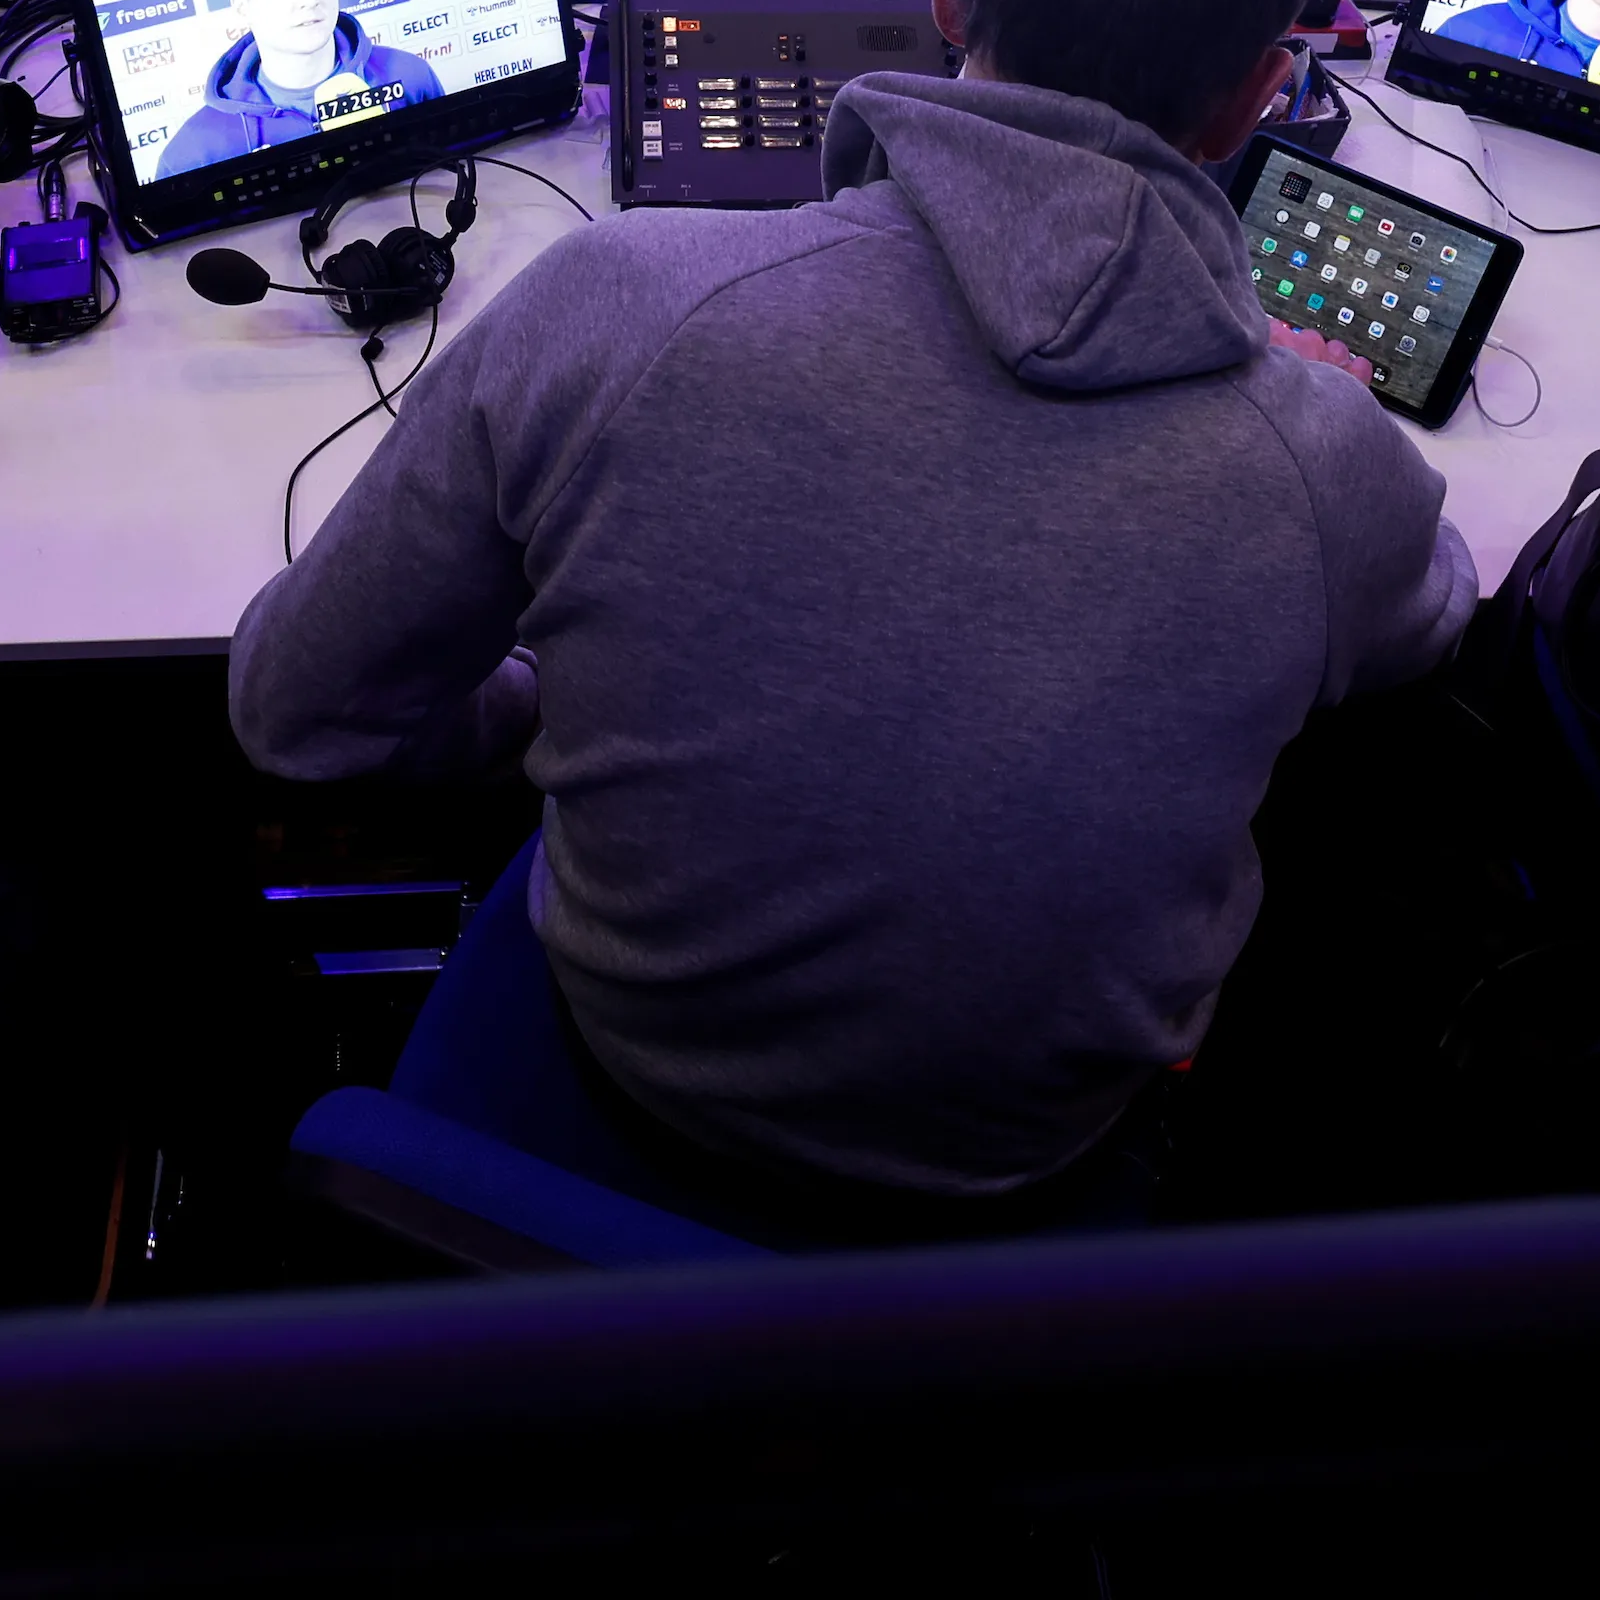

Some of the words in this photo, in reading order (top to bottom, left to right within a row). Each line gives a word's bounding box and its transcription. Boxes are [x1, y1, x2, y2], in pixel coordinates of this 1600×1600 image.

[402, 13, 450, 36] SELECT
[472, 23, 520, 46] SELECT
[124, 37, 172, 60] LIQUI
[129, 51, 175, 74] MOLY
[473, 68, 497, 84] HERE
[498, 64, 511, 78] TO
[511, 57, 534, 75] PLAY
[121, 95, 166, 117] ummel
[317, 81, 405, 121] 17:26:20
[130, 125, 169, 151] LECT
